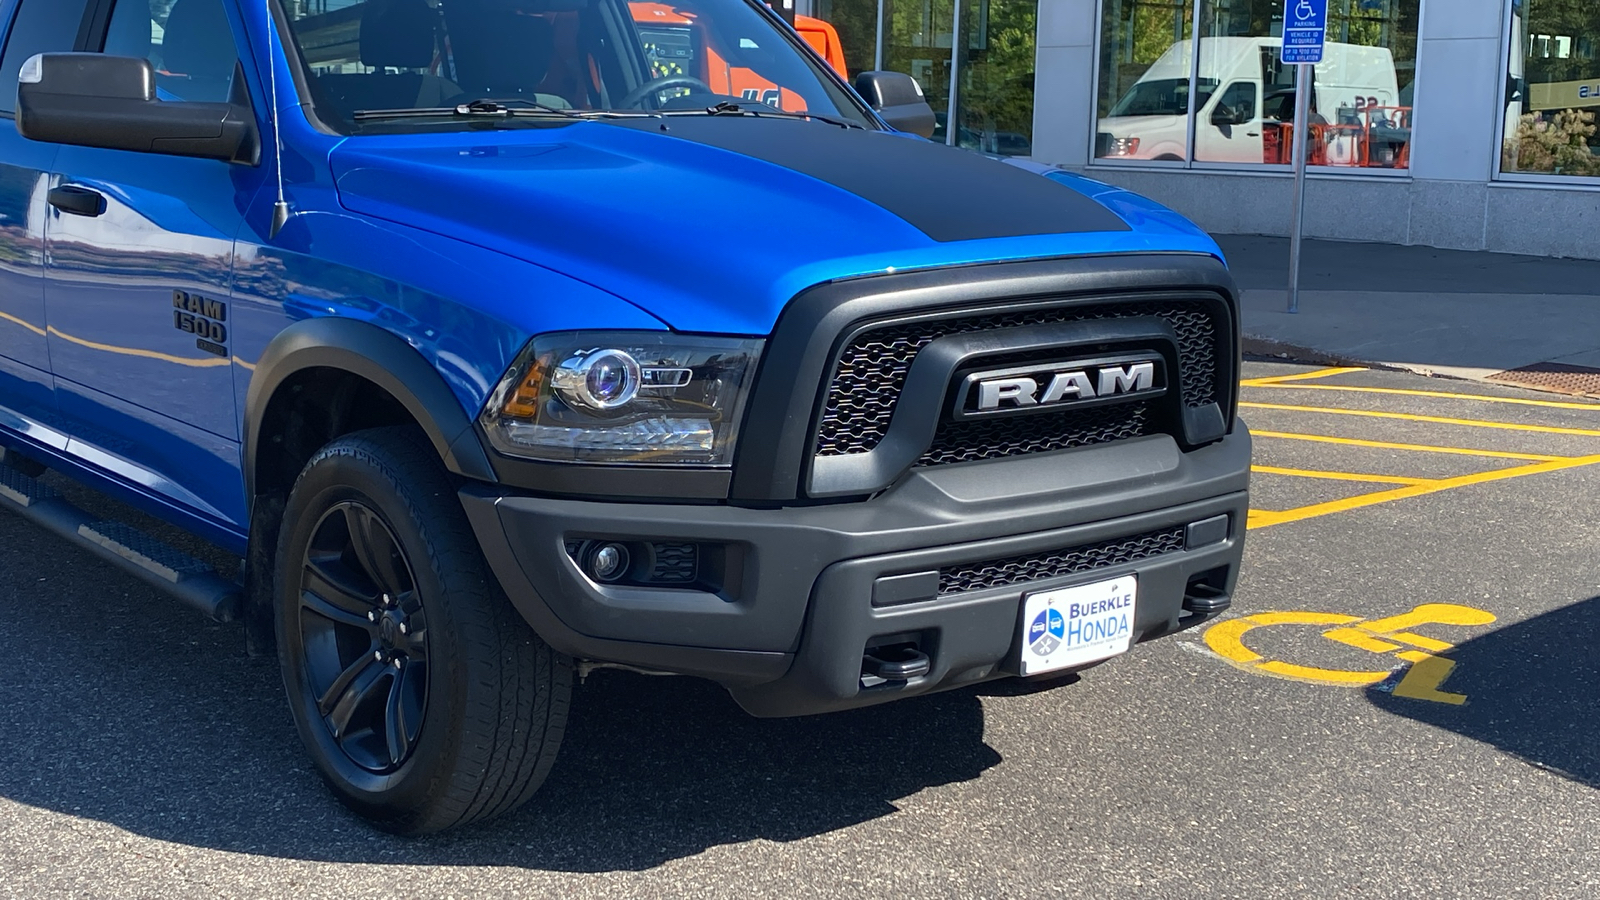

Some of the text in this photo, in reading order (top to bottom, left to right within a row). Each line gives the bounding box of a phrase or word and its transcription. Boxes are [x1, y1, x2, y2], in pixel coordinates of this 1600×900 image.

[173, 289, 226, 322] RAM
[173, 310, 227, 343] 1500
[978, 362, 1154, 410] RAM
[1069, 594, 1131, 619] BUERKLE
[1067, 613, 1128, 646] HONDA
